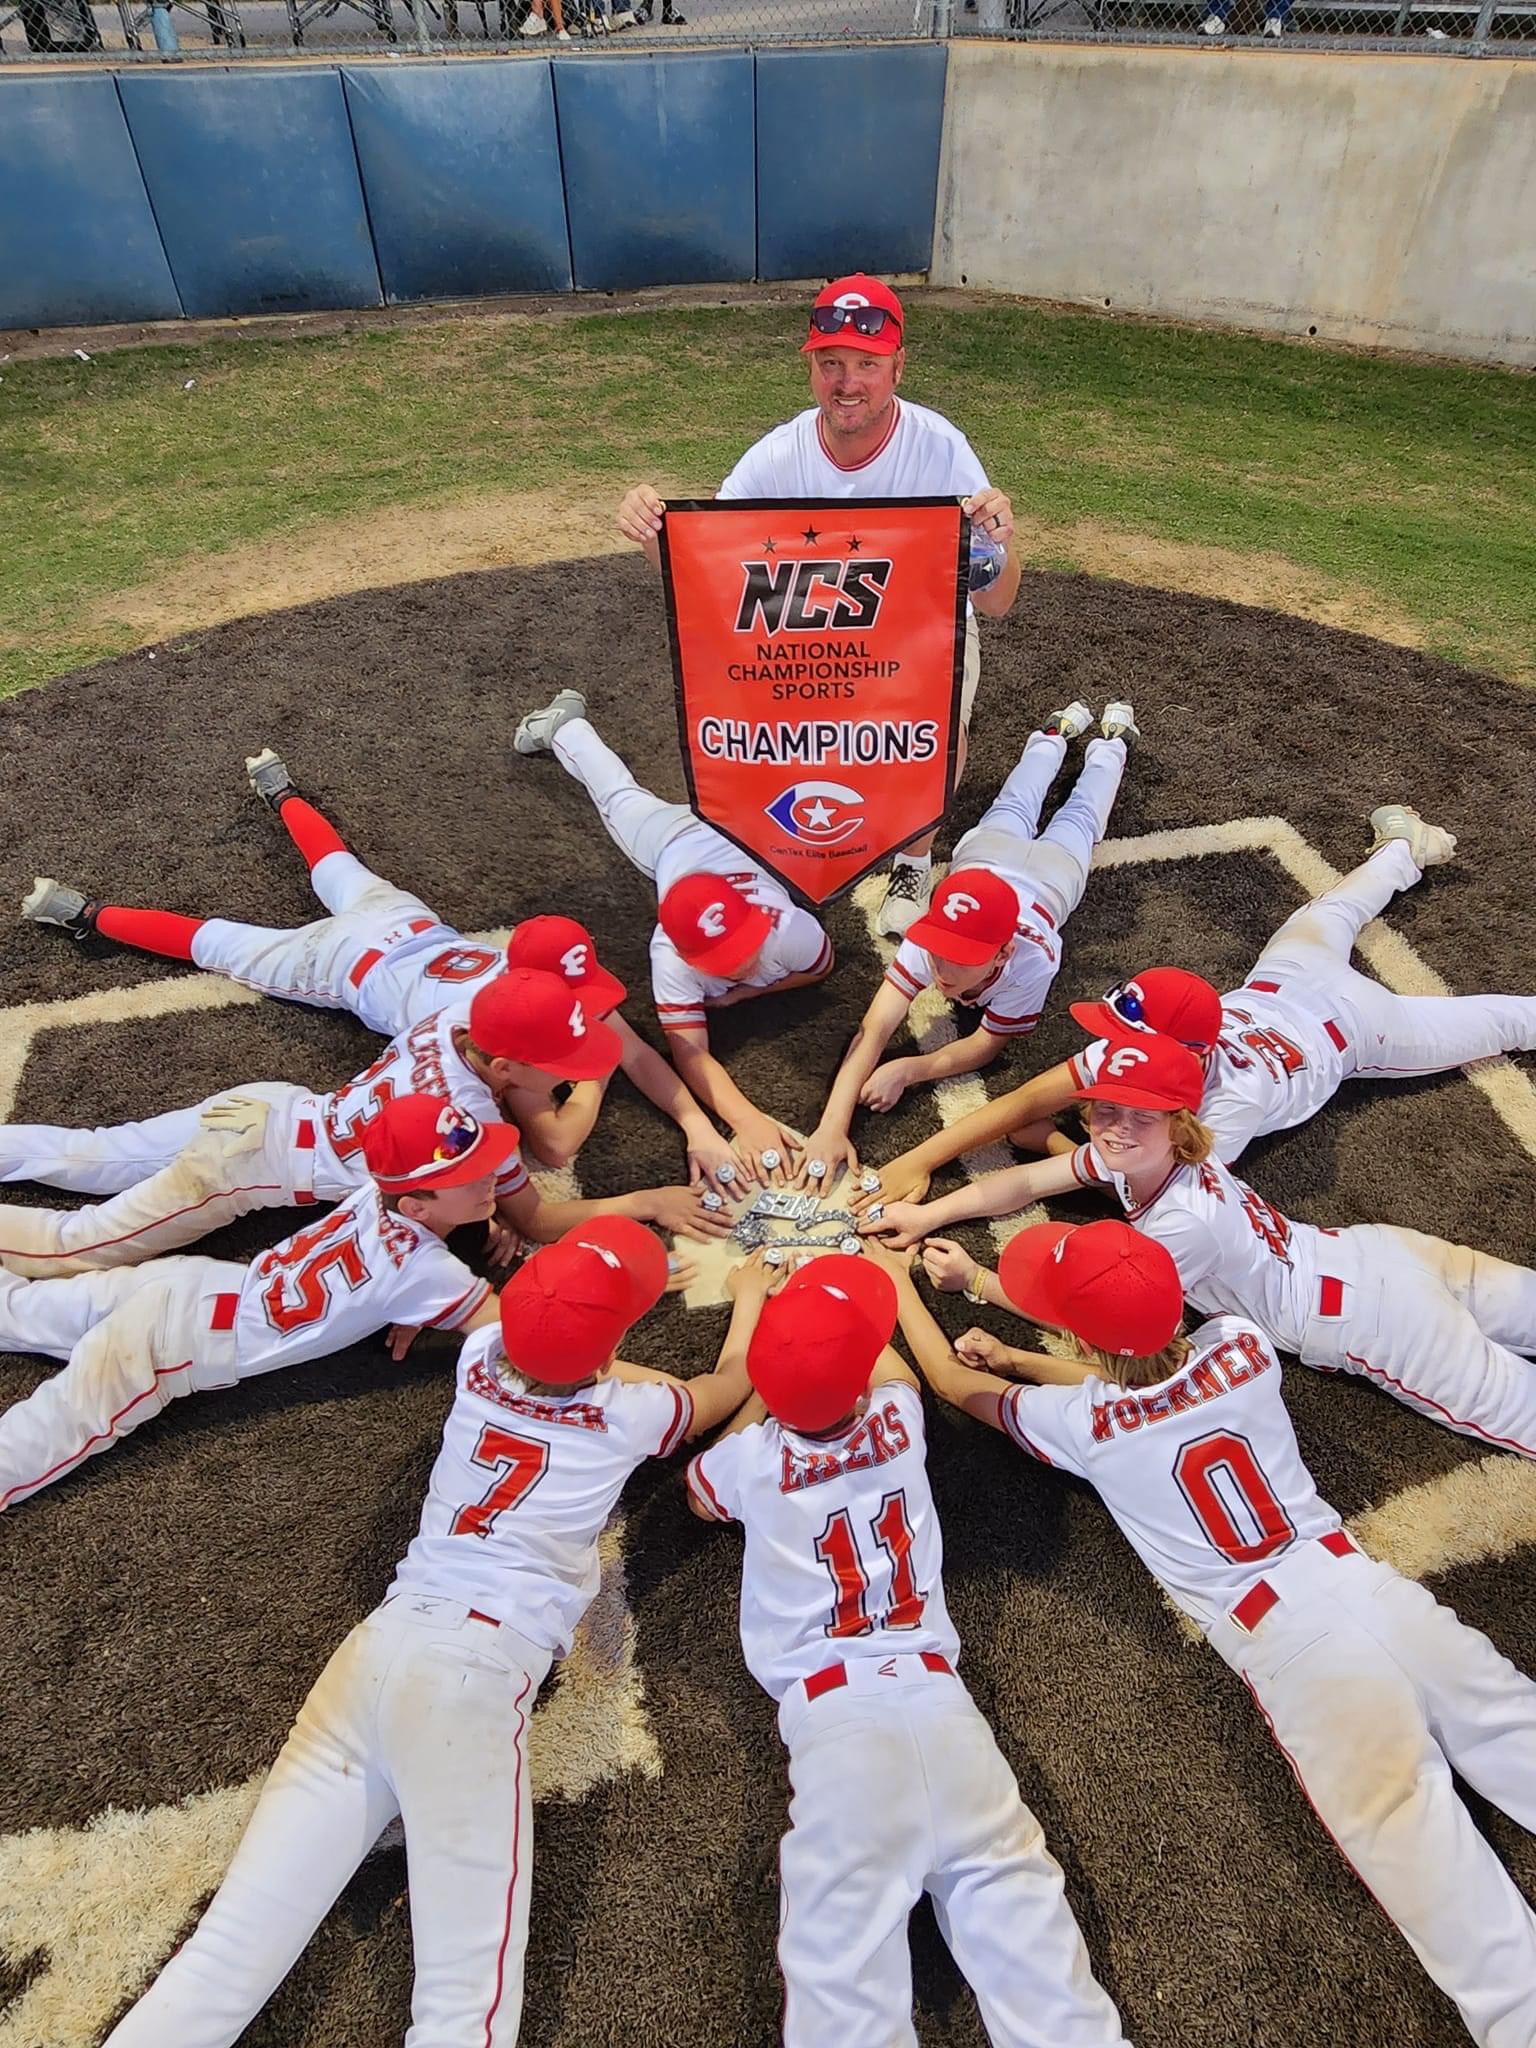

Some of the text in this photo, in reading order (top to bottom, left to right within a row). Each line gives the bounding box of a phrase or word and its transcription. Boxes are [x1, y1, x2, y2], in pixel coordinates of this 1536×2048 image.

[734, 559, 893, 638] NCS
[727, 661, 901, 682] CHAMPIONSHIP
[756, 641, 871, 661] NATIONAL
[772, 682, 855, 700] SPORTS
[698, 716, 939, 766] CHAMPIONS
[448, 1420, 551, 1540] 7
[1172, 1427, 1298, 1565] 0
[813, 1487, 929, 1638] 11
